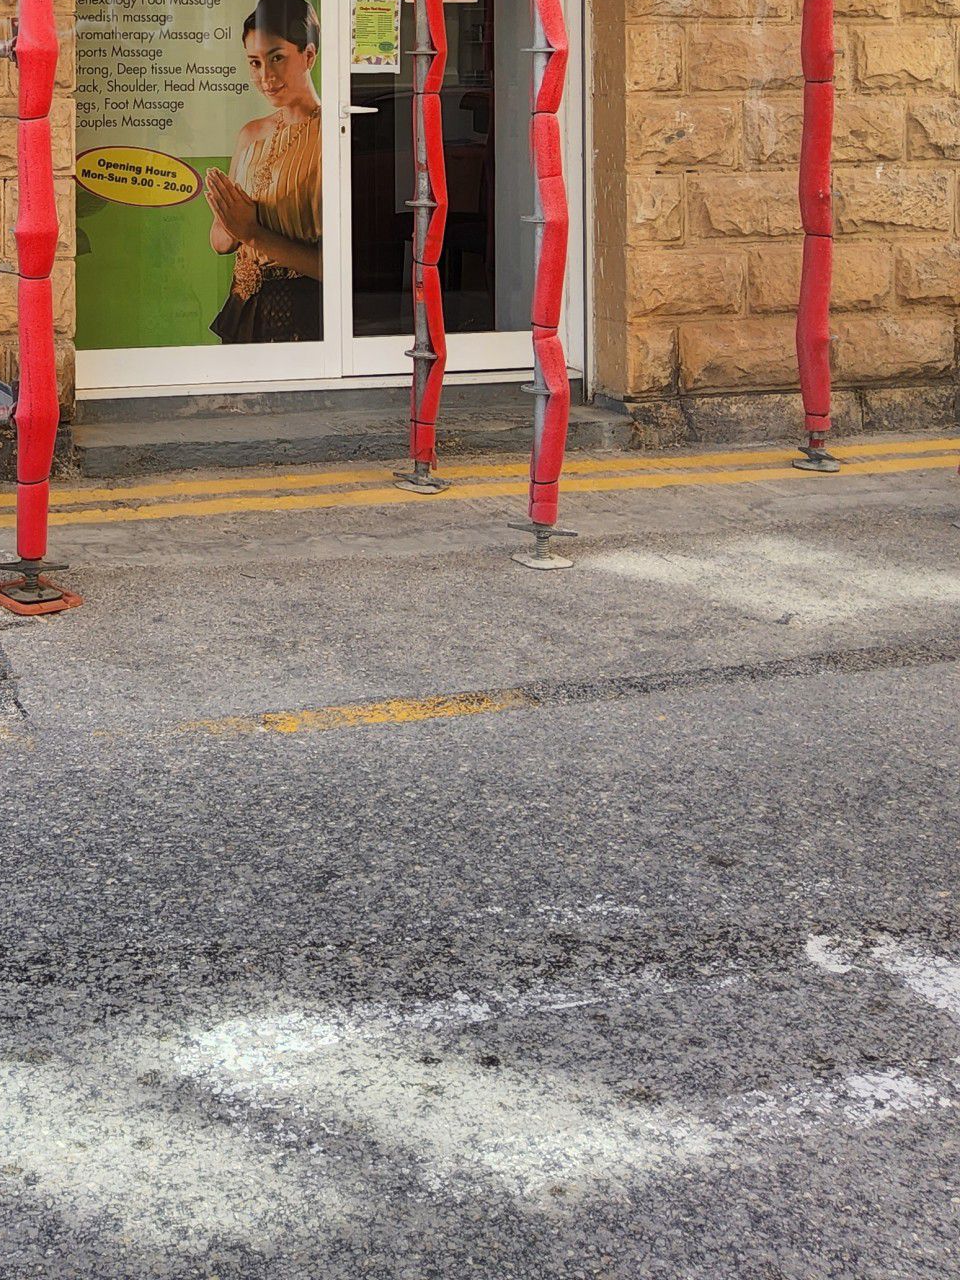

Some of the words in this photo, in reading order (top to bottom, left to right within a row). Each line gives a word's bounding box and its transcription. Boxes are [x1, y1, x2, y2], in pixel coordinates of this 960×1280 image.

[123, 14, 174, 26] massage
[159, 28, 211, 43] Massage
[214, 27, 232, 41] Oil
[76, 46, 107, 60] ports
[111, 45, 163, 61] Massage
[76, 63, 113, 79] trong,
[117, 63, 147, 78] Deep
[151, 63, 182, 75] tissue
[186, 64, 237, 78] Massage
[74, 79, 102, 94] ack,
[107, 79, 160, 94] Shoulder,
[164, 80, 195, 92] Head
[198, 81, 250, 95] Massage
[76, 100, 100, 114] egs,
[104, 98, 129, 110] Foot
[133, 98, 184, 113] Massage
[121, 115, 173, 130] Massage
[97, 158, 142, 175] Opening
[145, 165, 177, 179] Hours
[81, 168, 128, 184] Mon-Sun
[130, 176, 154, 188] 9.00
[163, 181, 193, 194] 20.00
